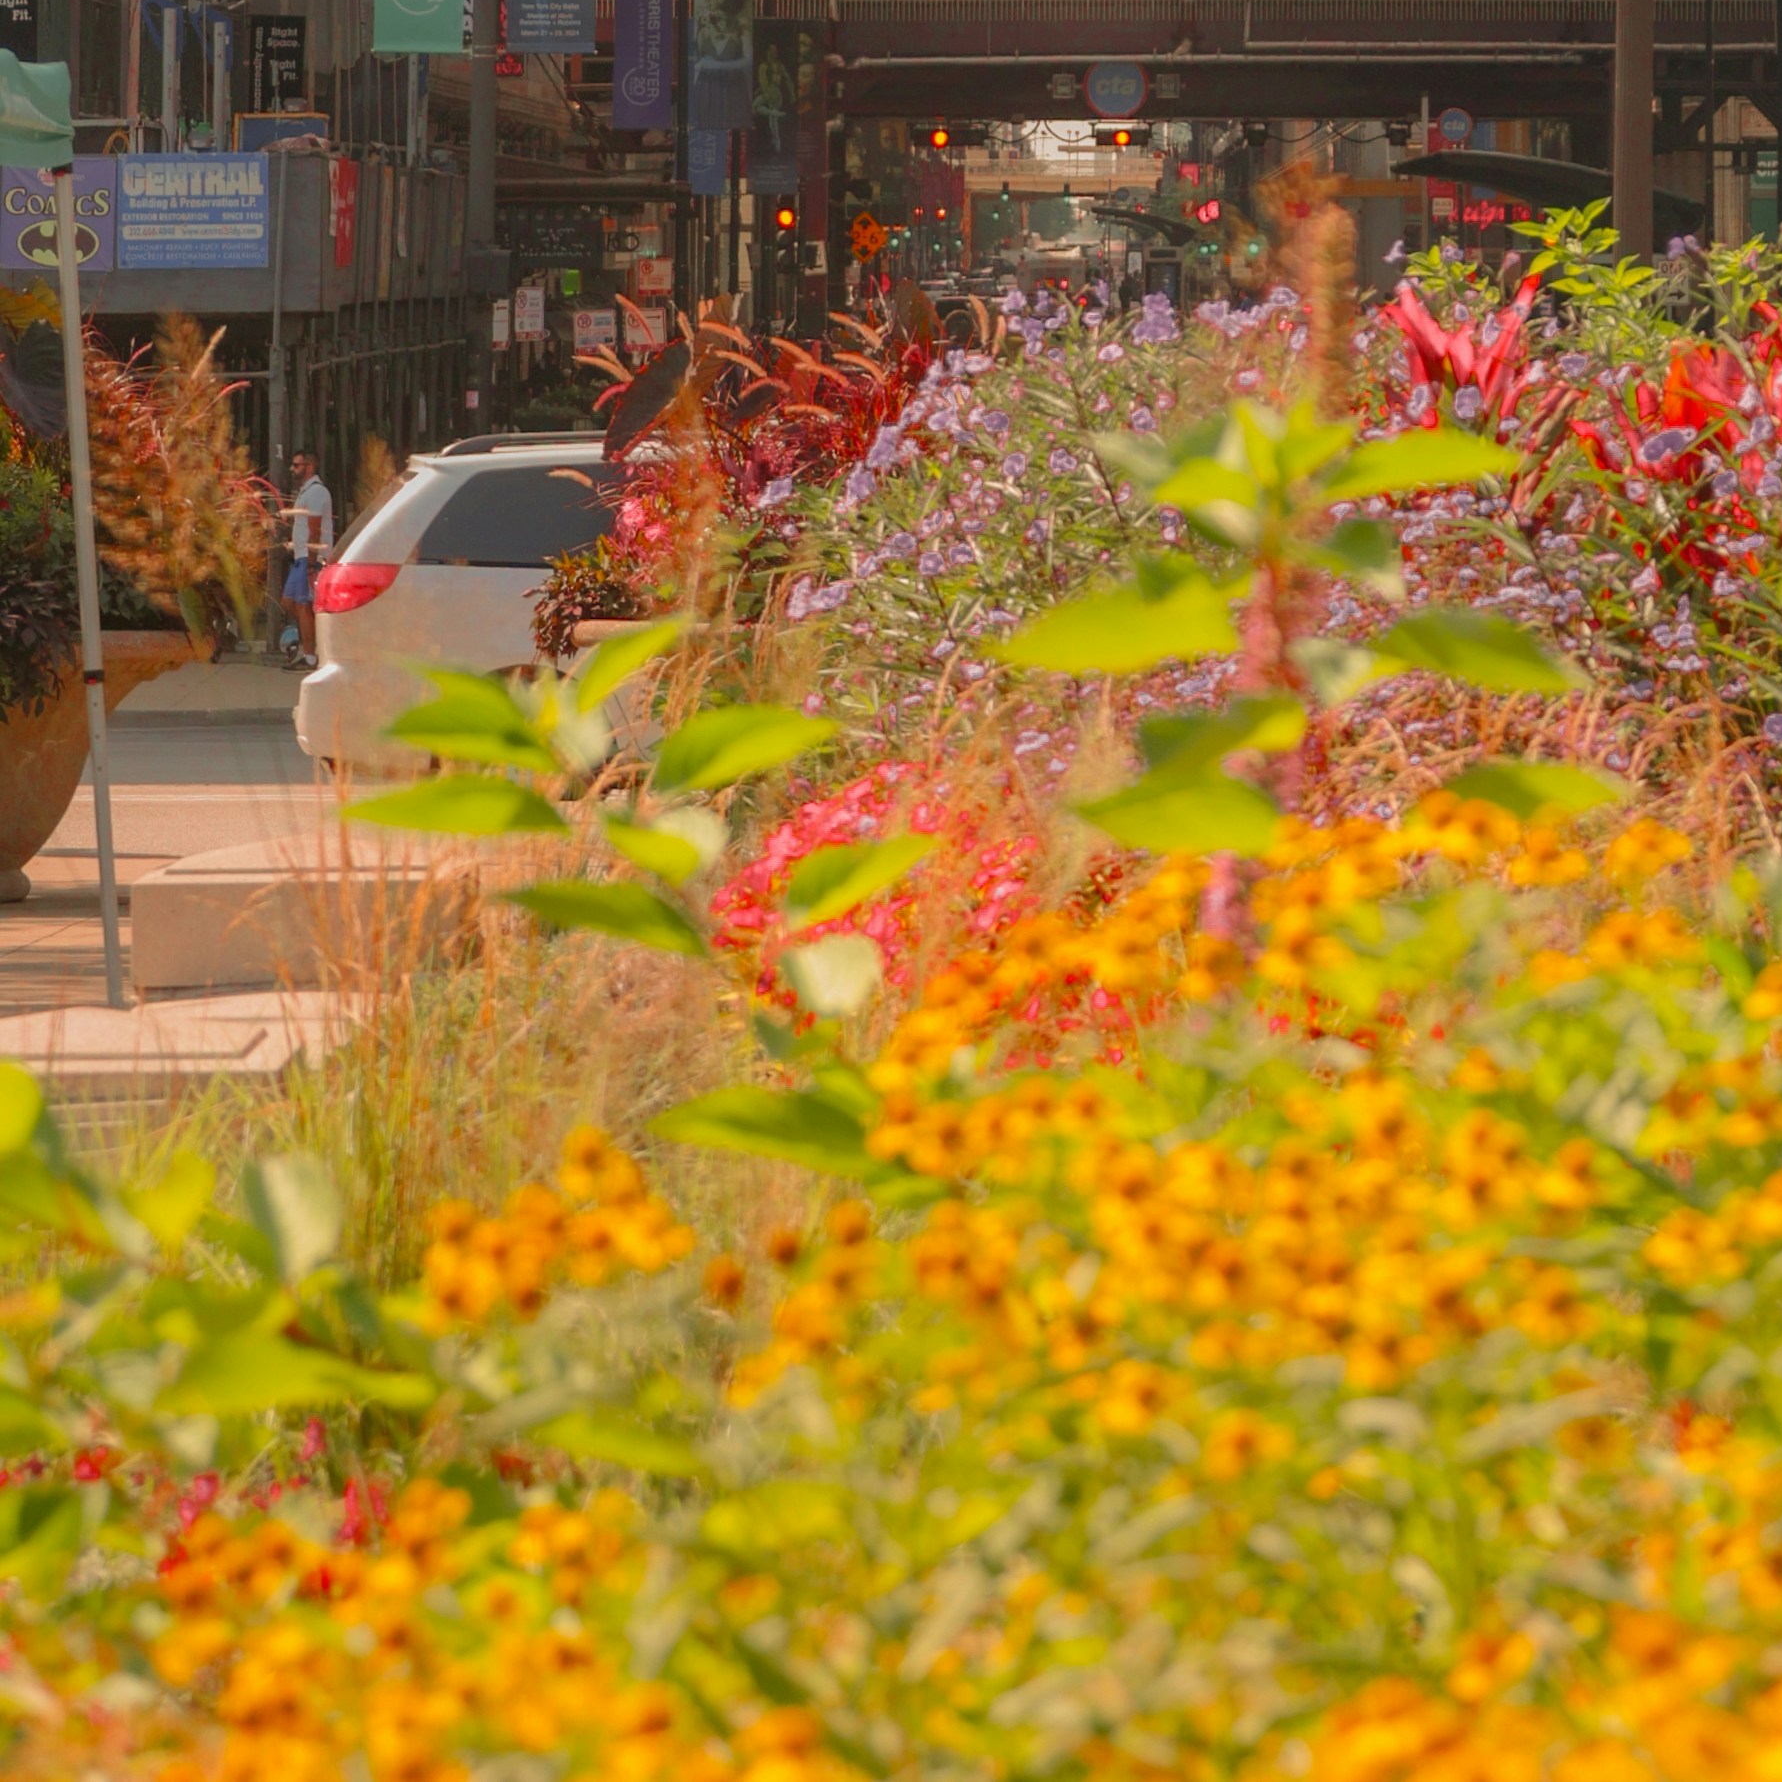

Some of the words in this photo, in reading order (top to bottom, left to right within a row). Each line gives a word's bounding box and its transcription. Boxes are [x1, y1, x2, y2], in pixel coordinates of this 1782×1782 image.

[550, 3, 561, 11] City
[12, 9, 33, 21] Fit.
[270, 27, 298, 39] Right
[647, 31, 660, 100] THEATER
[283, 71, 299, 81] Fit.
[633, 76, 645, 96] 20
[1095, 76, 1137, 96] cta
[122, 162, 264, 196] CENTRAL
[4, 187, 110, 216] COMCS
[130, 198, 169, 210] Building
[170, 198, 177, 208] &
[179, 198, 240, 209] Preservation
[241, 198, 257, 208] L.P.
[122, 213, 158, 221] EXTERIOR
[159, 213, 210, 221] RESTORATION
[222, 212, 244, 221] SINCE
